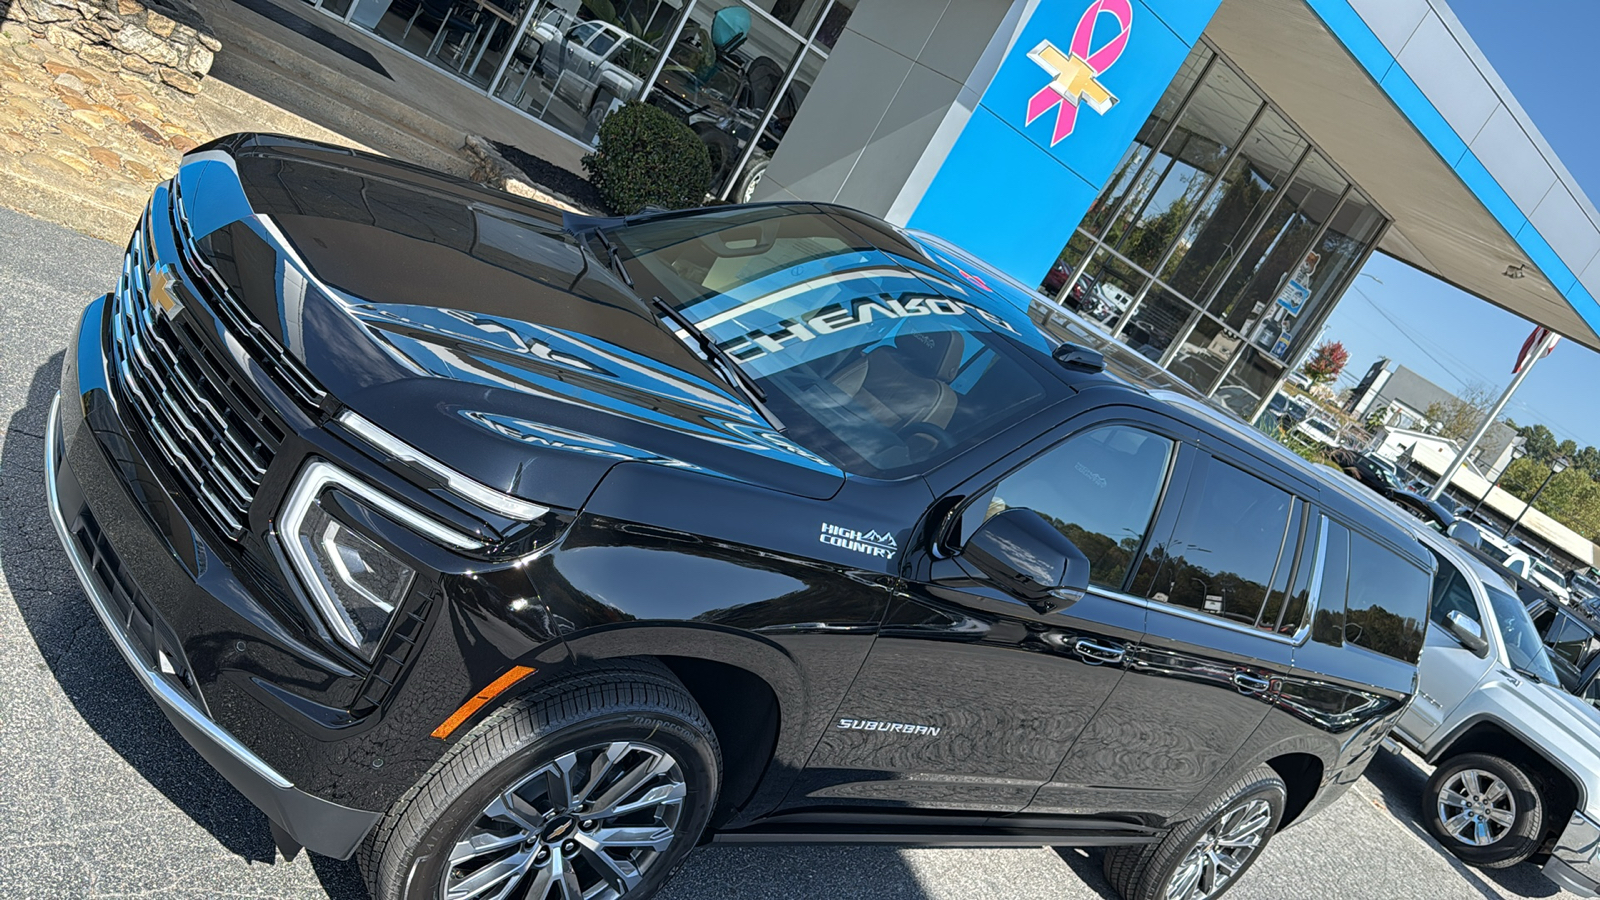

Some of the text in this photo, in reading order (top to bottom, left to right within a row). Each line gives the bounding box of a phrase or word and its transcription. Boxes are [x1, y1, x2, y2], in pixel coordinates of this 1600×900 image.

[821, 522, 863, 541] HIGH
[820, 533, 897, 559] COUNTRY
[837, 719, 941, 736] SUBURBAN
